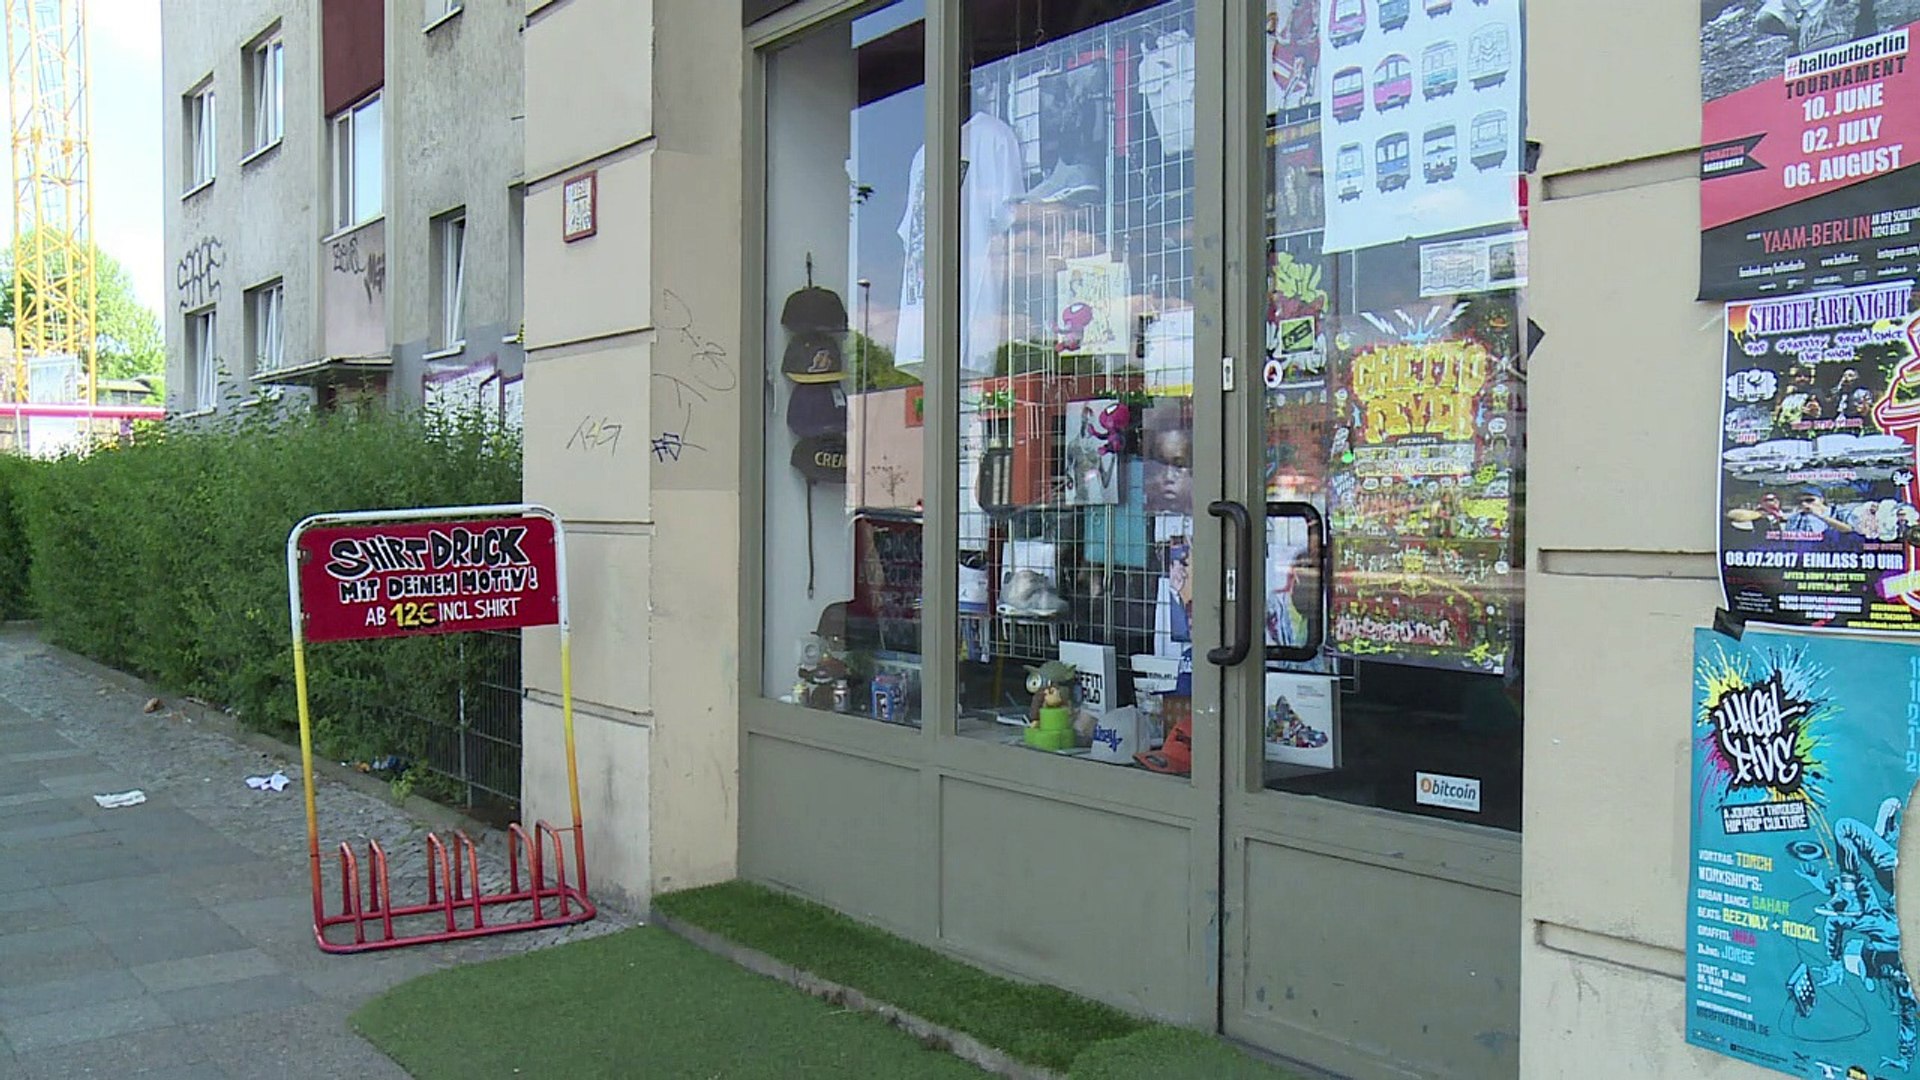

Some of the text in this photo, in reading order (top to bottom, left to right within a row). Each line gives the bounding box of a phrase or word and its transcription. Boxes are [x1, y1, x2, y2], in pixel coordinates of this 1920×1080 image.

[1787, 35, 1906, 76] #balloutberlin
[1786, 56, 1907, 99] TOURNAMENT
[1802, 83, 1884, 122] 10. JUNE
[1802, 115, 1882, 153] 02. JULY
[1783, 145, 1903, 189] 06. AUGUST
[1762, 215, 1871, 254] YAAM-BERLIN
[1749, 289, 1911, 334] STREET ART NIGHT
[1353, 342, 1488, 401] GHETTO
[1725, 551, 1904, 571] 08.07.2017 EINLASS 19 UHR
[365, 596, 522, 628] AB 12€ INCL SHIRT
[1432, 780, 1476, 800] bitcoin
[1766, 801, 1804, 817] THROUGH
[1726, 815, 1808, 833] HIP HOP CULTURE
[1698, 866, 1763, 892] WORKSHOPS:
[1736, 851, 1773, 872] TORCH
